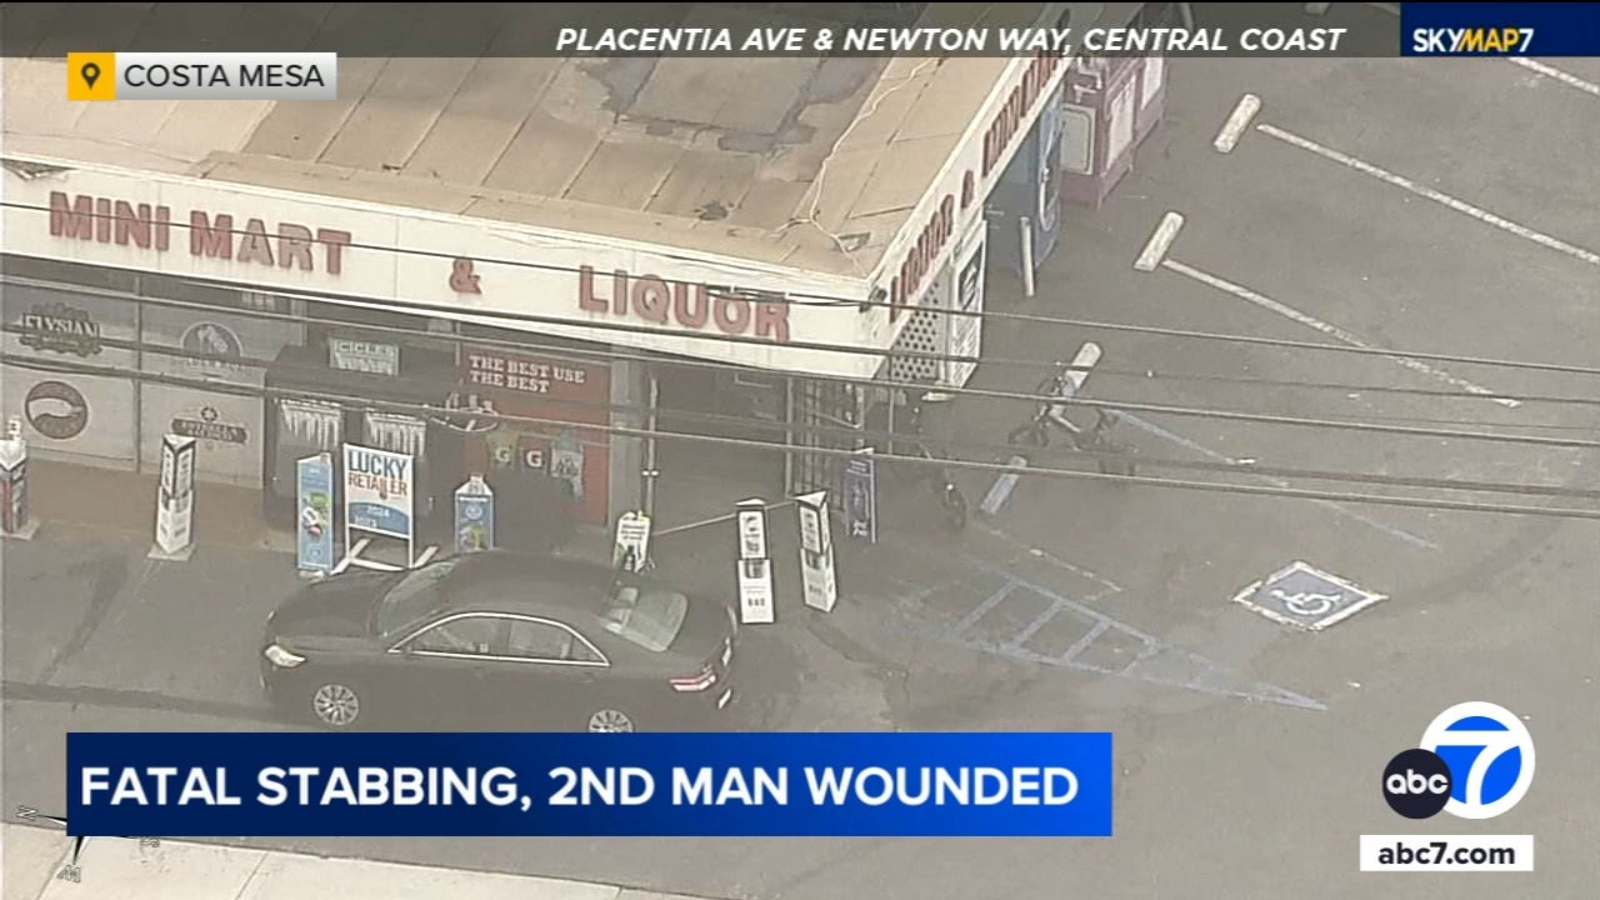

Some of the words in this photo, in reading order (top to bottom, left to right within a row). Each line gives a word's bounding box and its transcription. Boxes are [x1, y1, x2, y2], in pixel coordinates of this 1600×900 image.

[49, 190, 170, 251] MINI
[190, 209, 351, 276] MART
[449, 256, 482, 295] &
[578, 264, 791, 342] LIQUOR
[469, 355, 504, 372] THE
[507, 360, 550, 378] BEST
[553, 366, 585, 384] USE
[469, 369, 504, 387] THE
[506, 375, 550, 393] BEST
[349, 450, 407, 481] LUCKY
[526, 450, 542, 467] G
